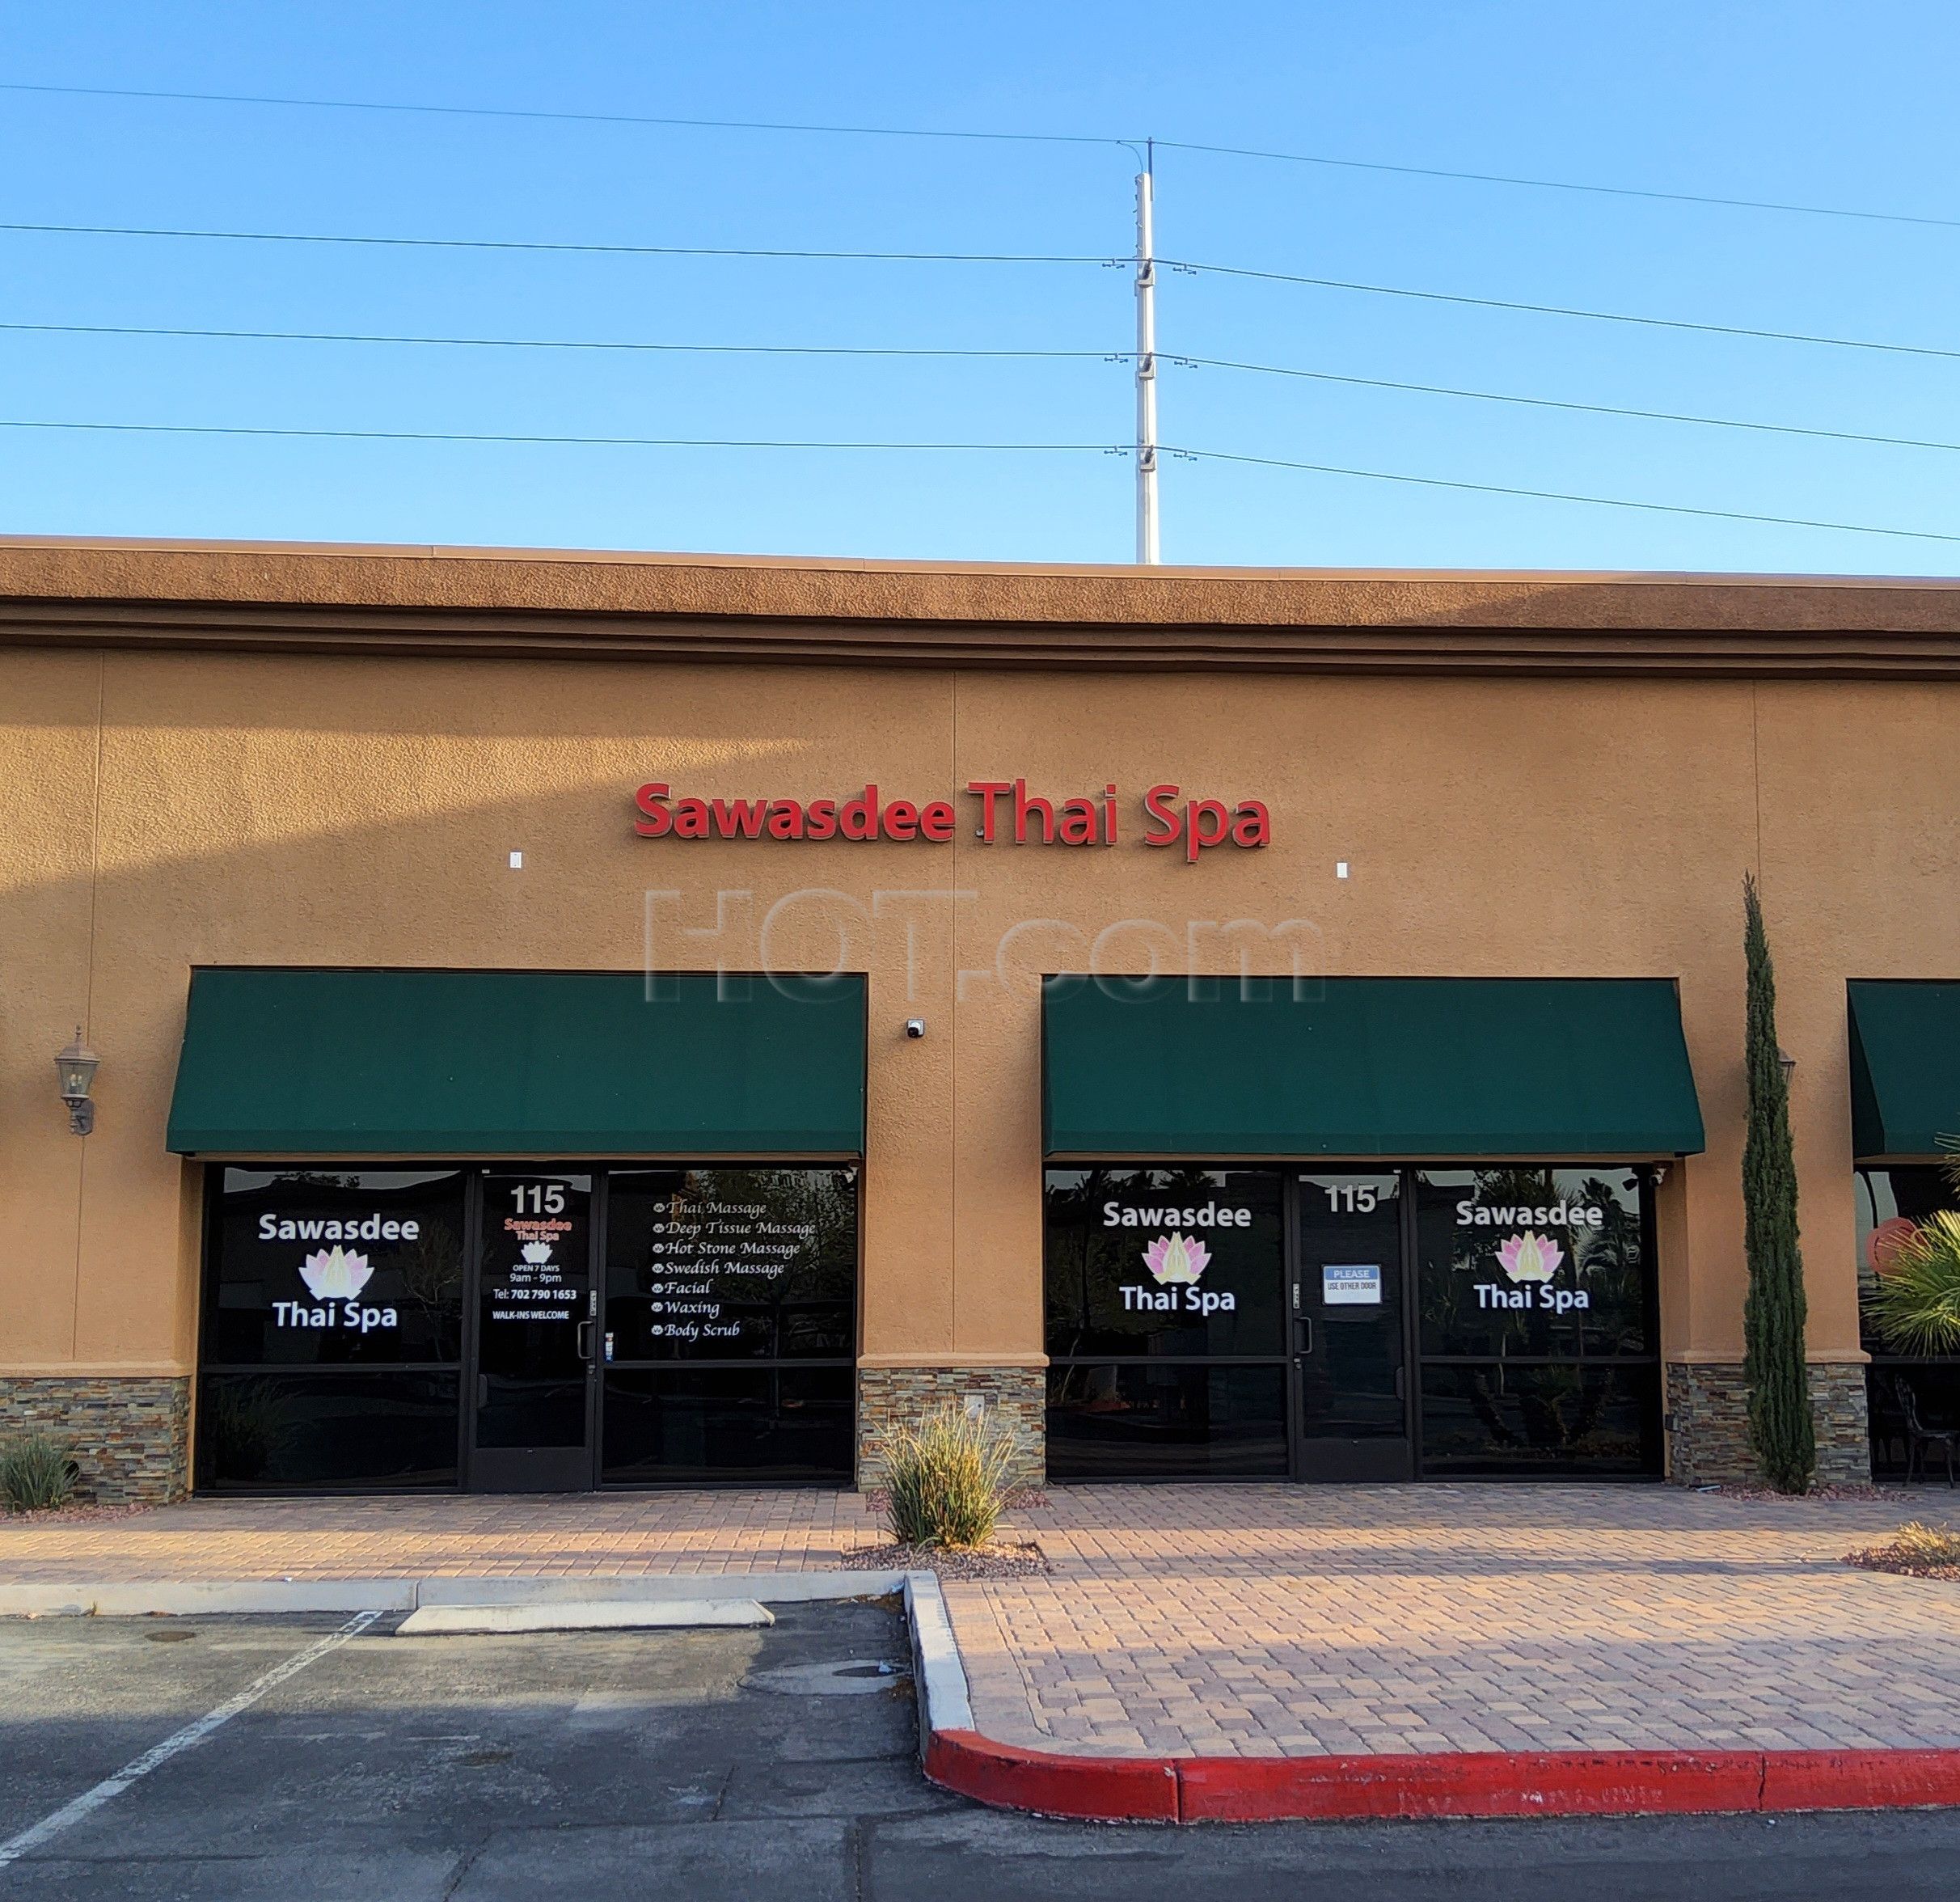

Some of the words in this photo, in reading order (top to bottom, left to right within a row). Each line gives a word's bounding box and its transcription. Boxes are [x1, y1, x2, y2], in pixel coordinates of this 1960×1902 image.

[634, 782, 955, 842] Sawasdee
[968, 779, 1117, 846] Thai
[1145, 784, 1270, 863] Spa
[511, 1185, 564, 1214] 115
[665, 1198, 703, 1214] Thai
[706, 1202, 767, 1219] Massage
[1324, 1185, 1376, 1213] 115
[1103, 1201, 1252, 1227] Sawasdee
[1456, 1199, 1603, 1226] Sawasdee
[258, 1213, 420, 1241] Sawasdee
[504, 1217, 572, 1231] Sawasdee
[665, 1221, 701, 1240] Deep
[705, 1219, 752, 1234] Tissue
[755, 1222, 816, 1240] Massage
[515, 1231, 539, 1241] Thai
[539, 1231, 560, 1242] Spa
[665, 1239, 694, 1254] Hot
[699, 1242, 736, 1254] Stone
[740, 1242, 800, 1260] Massage
[509, 1274, 532, 1283] 9am
[539, 1274, 562, 1284] 9pm
[665, 1259, 720, 1274] Swedish
[724, 1262, 784, 1280] Massage
[1334, 1270, 1370, 1279] PLEASE
[492, 1289, 509, 1300] Tel:
[511, 1290, 530, 1300] 702
[532, 1290, 551, 1300] 790
[553, 1290, 577, 1300] 1653
[665, 1279, 714, 1294] Facial
[1328, 1282, 1338, 1291] USE
[1340, 1282, 1359, 1291] OTHER
[1361, 1282, 1376, 1290] DOOR
[665, 1301, 720, 1319] Waxing
[1118, 1285, 1177, 1310] Thai
[1185, 1286, 1236, 1317] Spa
[1473, 1284, 1531, 1308] Thai
[1540, 1284, 1589, 1315] Spa
[272, 1301, 335, 1327] Thai
[344, 1302, 397, 1333] Spa
[492, 1311, 530, 1320] WALK-INS
[530, 1311, 569, 1319] WELCOME
[665, 1321, 699, 1342] Body
[703, 1321, 741, 1336] Scrub
